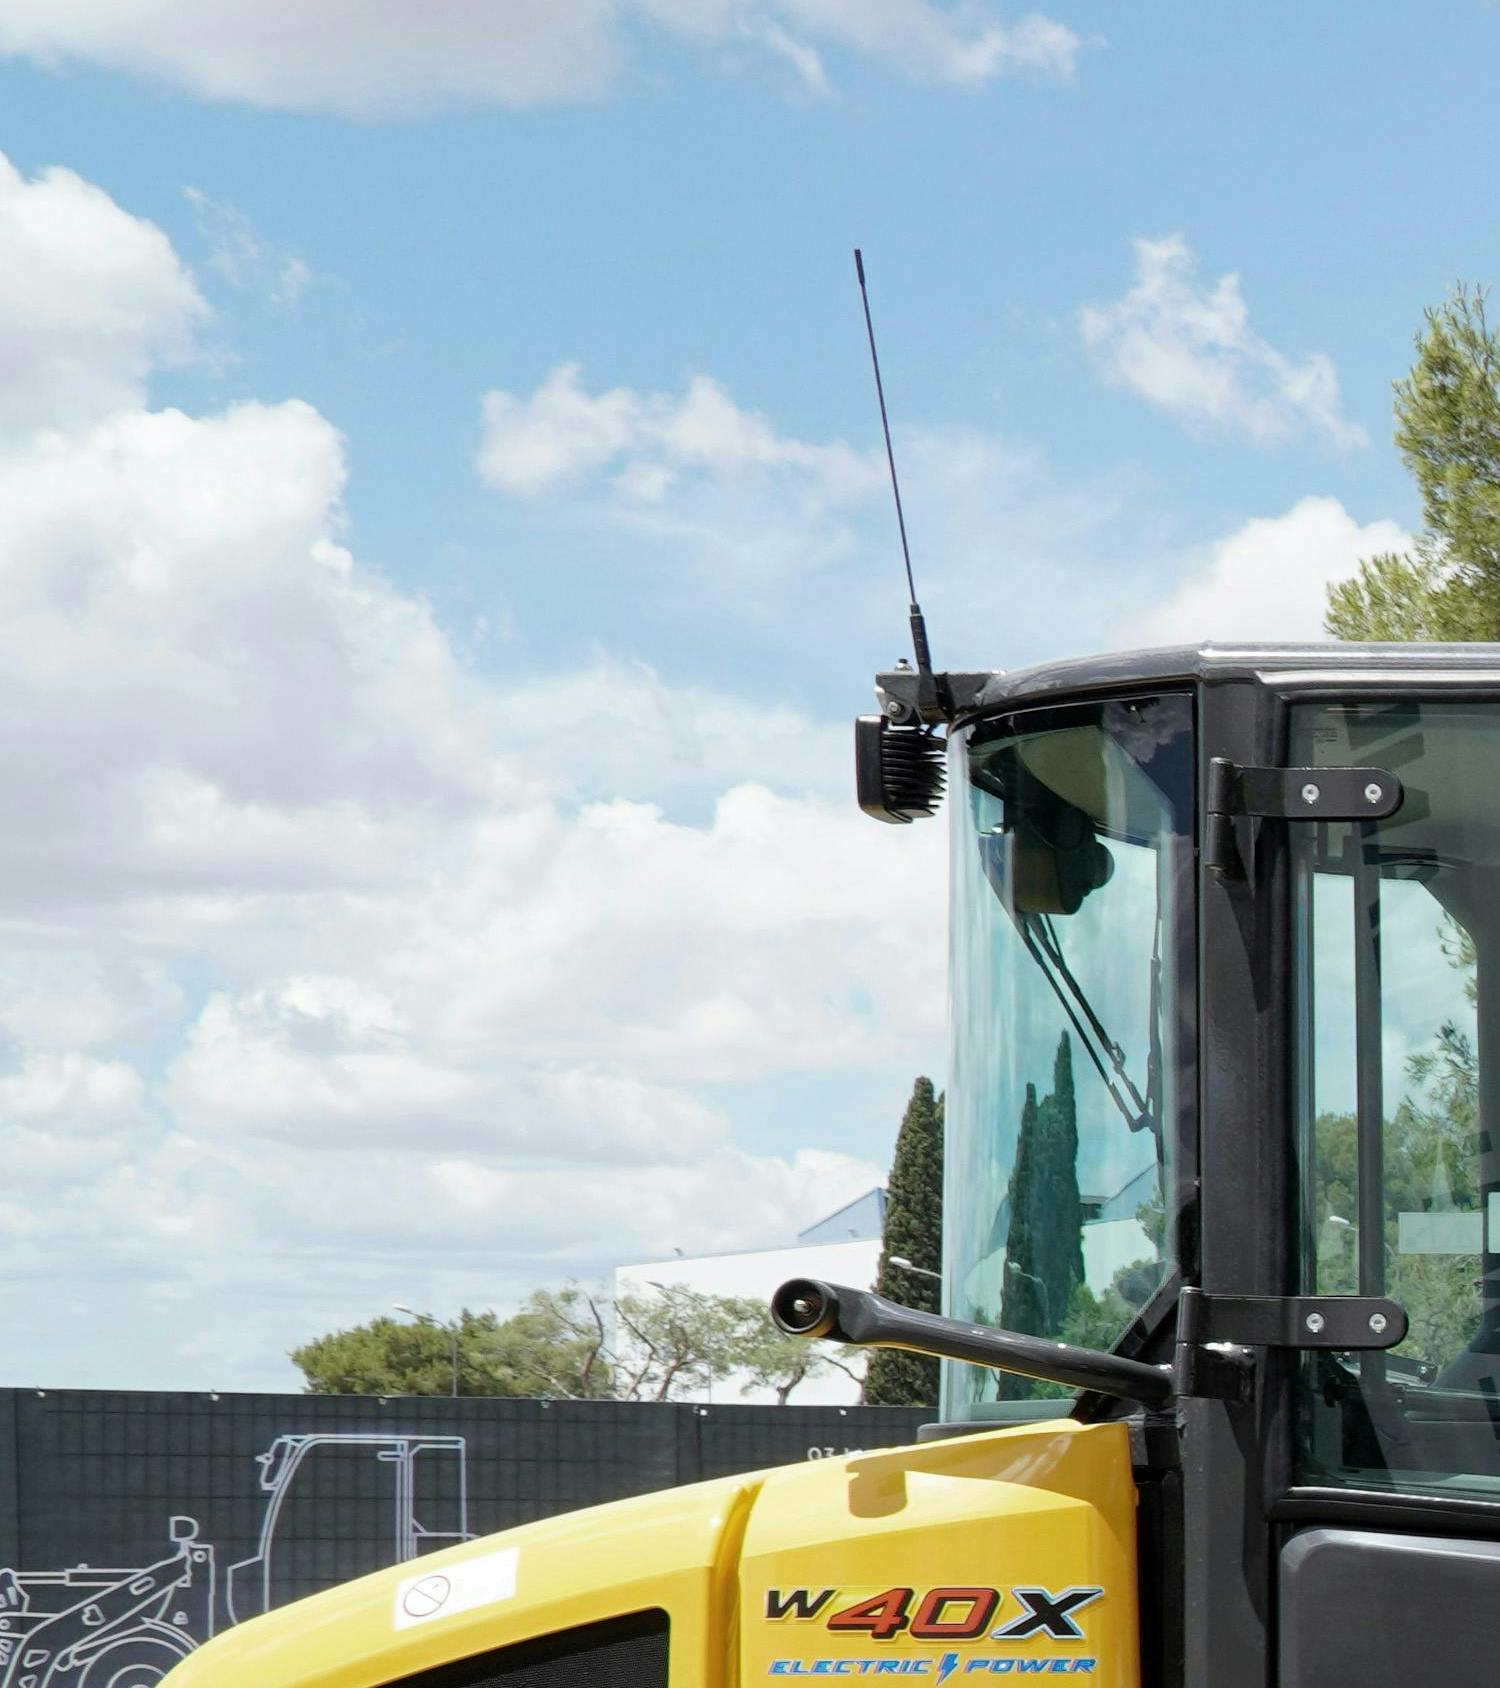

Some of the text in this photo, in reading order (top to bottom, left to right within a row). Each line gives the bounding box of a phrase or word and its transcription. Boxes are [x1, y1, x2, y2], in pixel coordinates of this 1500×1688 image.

[763, 1586, 1105, 1641] W40X
[768, 1657, 1098, 1676] ELECTRIC POWER
